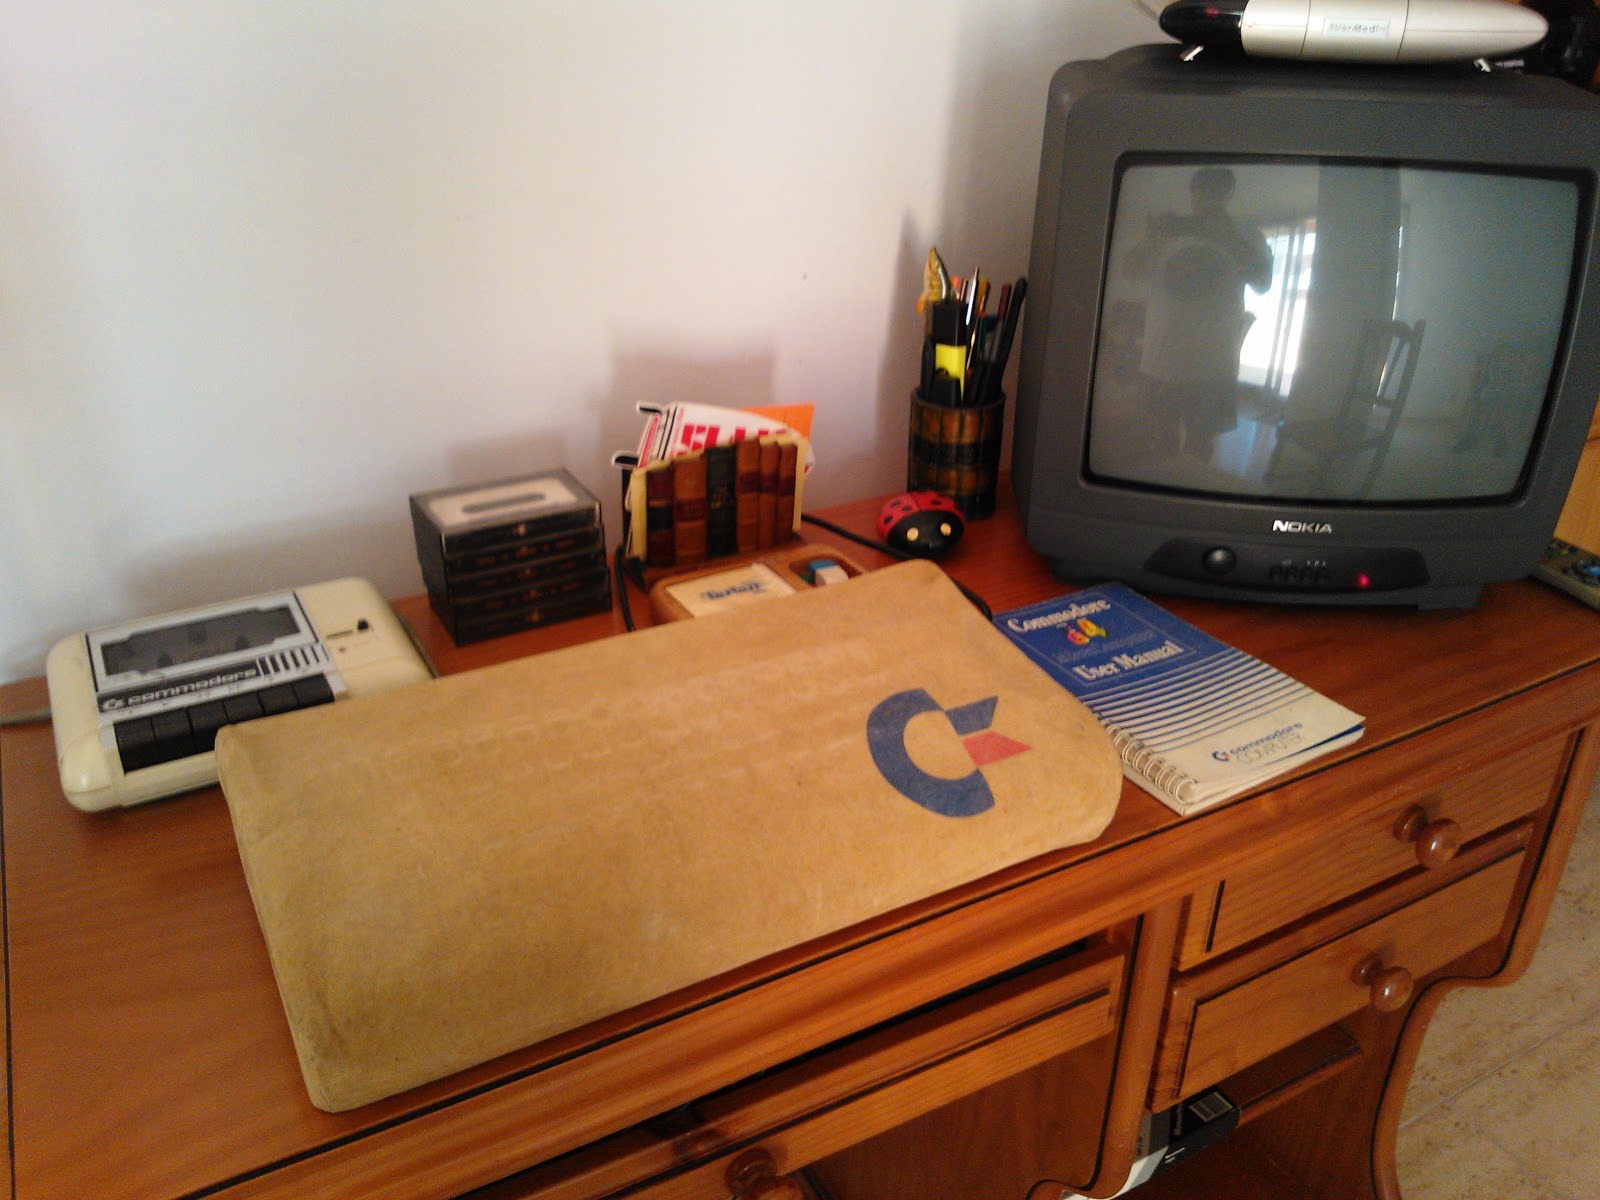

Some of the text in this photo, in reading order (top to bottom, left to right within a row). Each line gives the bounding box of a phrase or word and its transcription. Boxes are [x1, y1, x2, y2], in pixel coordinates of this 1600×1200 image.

[1272, 519, 1333, 534] NOKIA
[1007, 599, 1111, 633] Commodore
[1072, 664, 1121, 681] User
[1111, 639, 1185, 671] Manual
[127, 668, 257, 707] commodore
[1230, 722, 1303, 754] commodore
